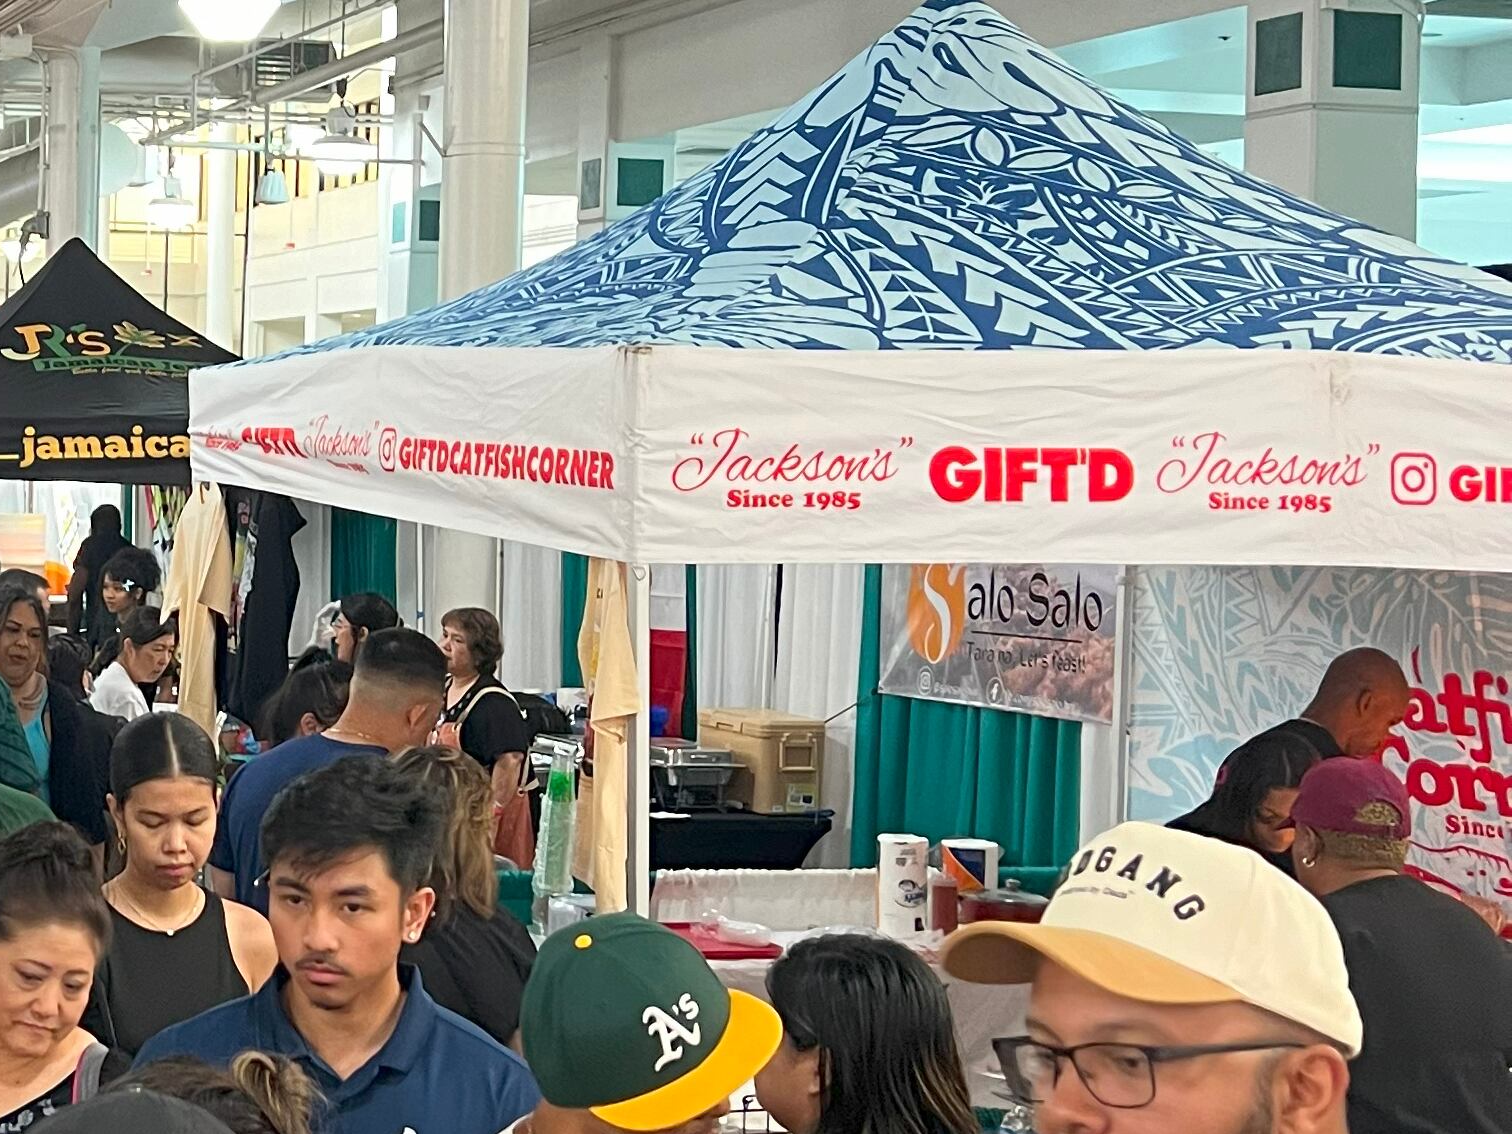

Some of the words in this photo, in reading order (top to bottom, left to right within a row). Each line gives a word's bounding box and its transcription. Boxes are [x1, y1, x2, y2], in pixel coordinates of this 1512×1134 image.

[399, 437, 615, 489] GIFTDCATFISHCORNER
[929, 445, 1135, 503] GIFT'D
[726, 489, 793, 507] Since
[802, 490, 861, 510] 1985
[1208, 492, 1269, 510] Since
[1277, 494, 1332, 512] 1985
[1026, 569, 1103, 632] Salo
[1052, 655, 1086, 674] feast!
[642, 992, 702, 1072] A's
